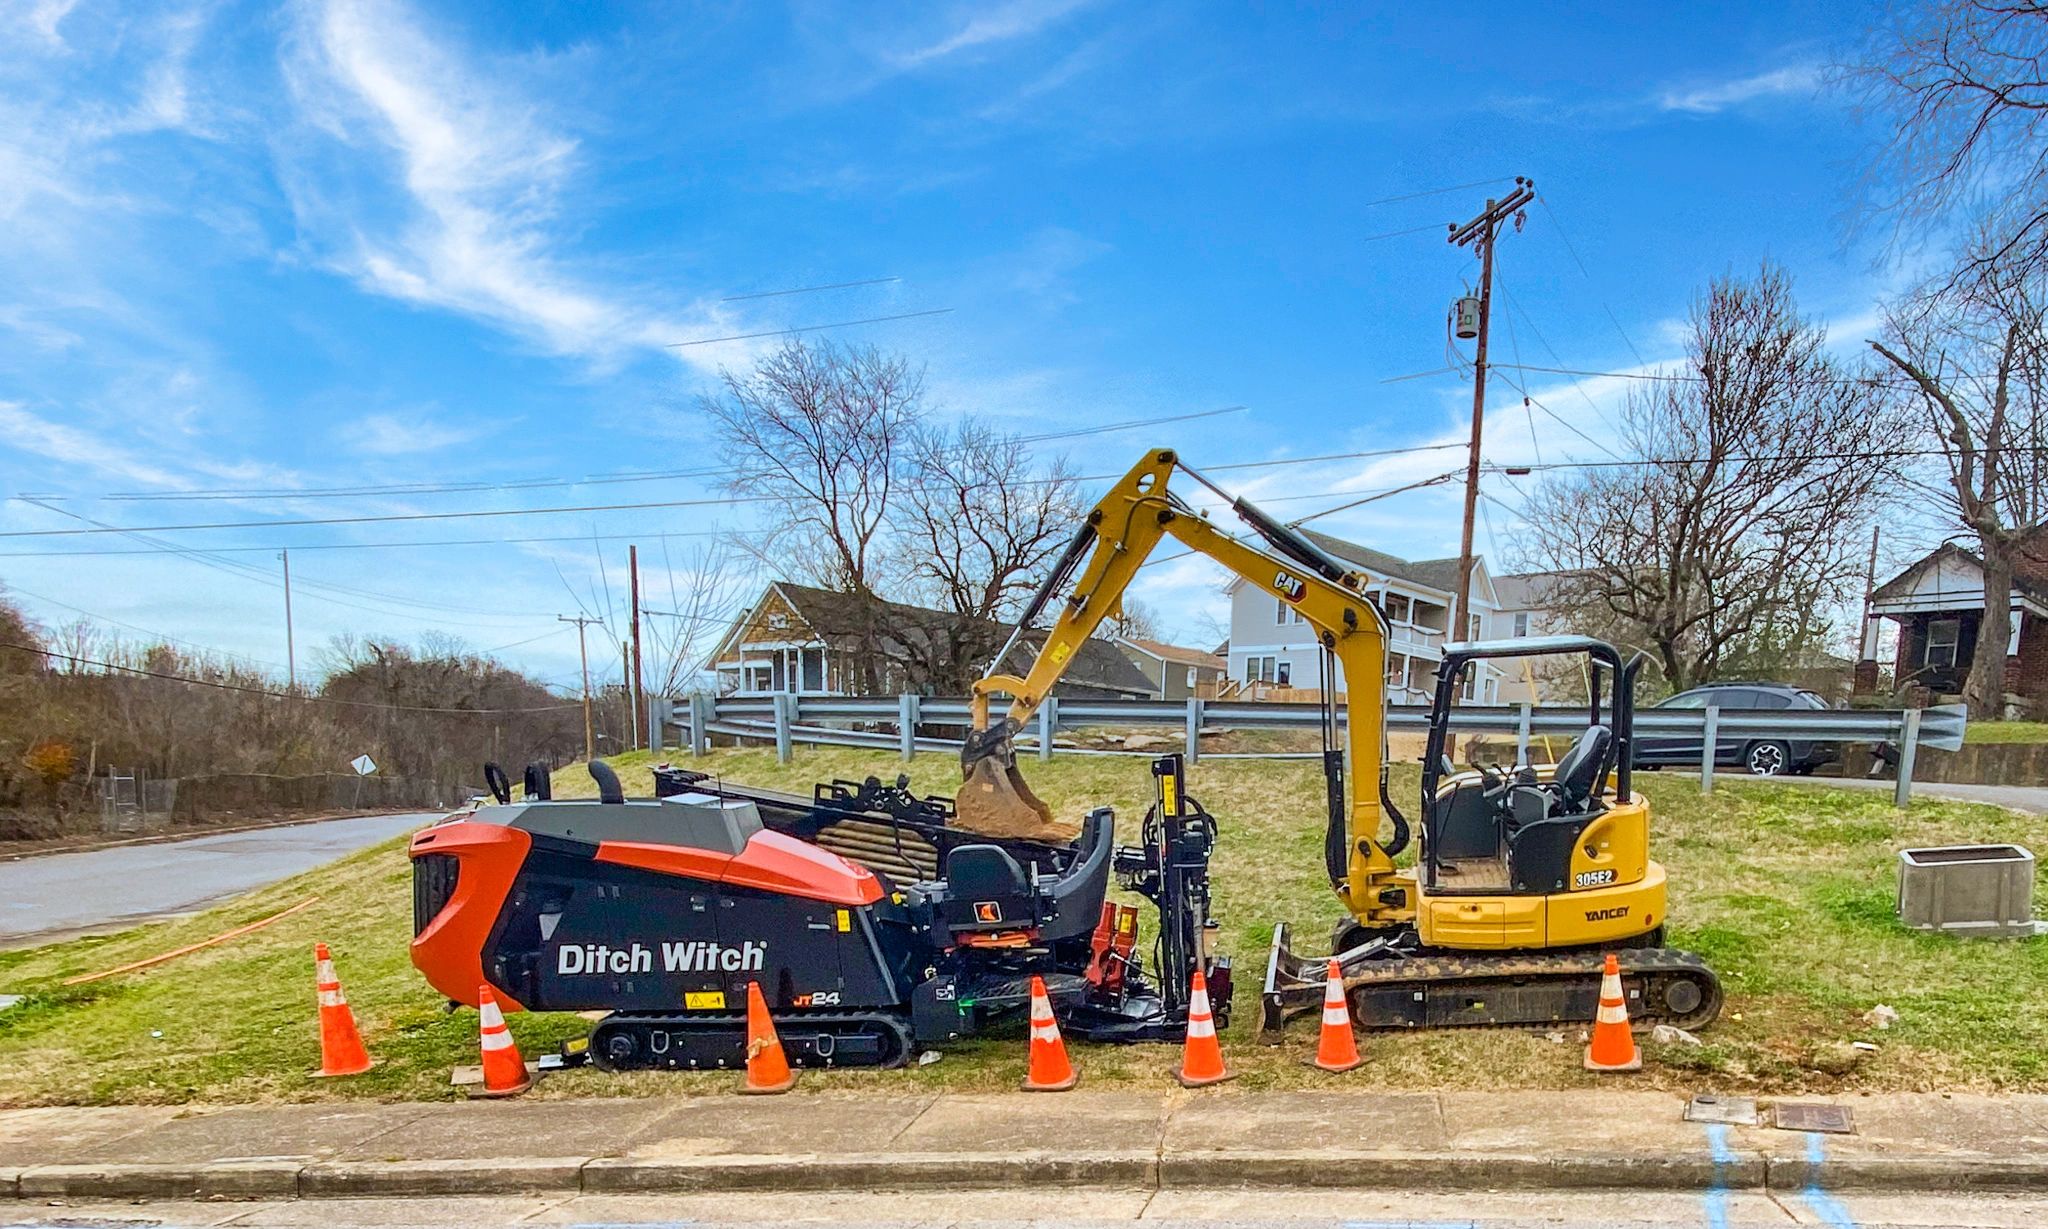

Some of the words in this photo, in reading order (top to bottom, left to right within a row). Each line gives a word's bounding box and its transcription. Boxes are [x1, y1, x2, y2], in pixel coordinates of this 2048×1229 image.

[1273, 571, 1303, 597] CAT
[1575, 870, 1613, 887] 305E2
[1585, 906, 1630, 922] YANCEY
[558, 943, 652, 974] Ditch
[661, 941, 764, 972] Witch
